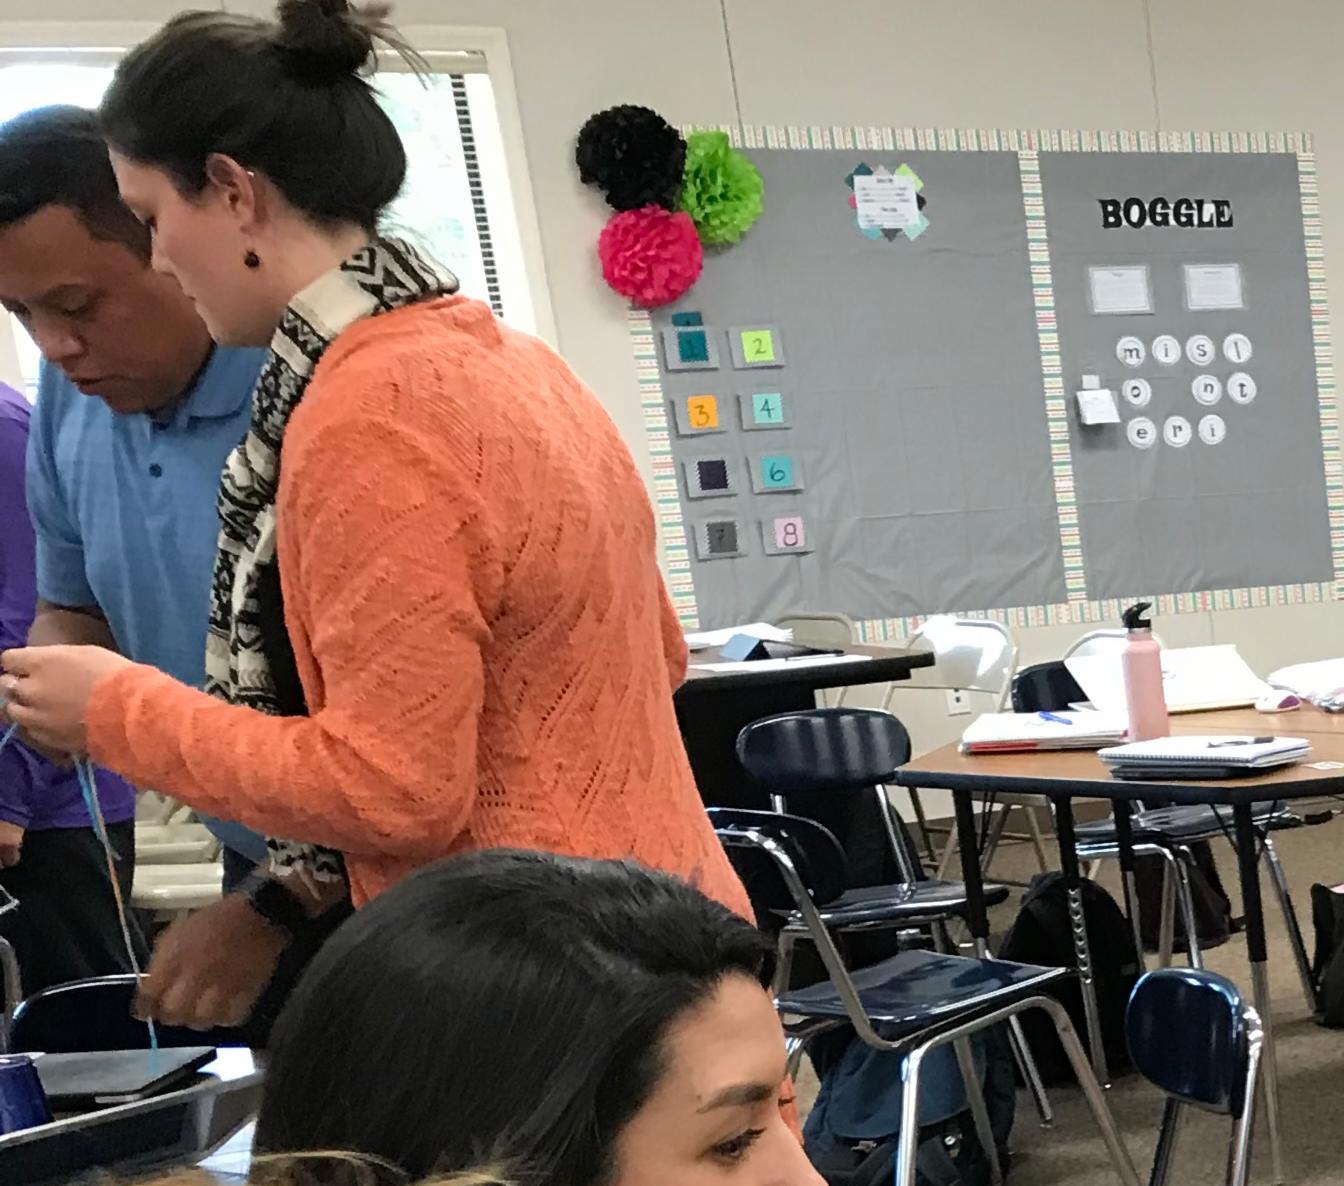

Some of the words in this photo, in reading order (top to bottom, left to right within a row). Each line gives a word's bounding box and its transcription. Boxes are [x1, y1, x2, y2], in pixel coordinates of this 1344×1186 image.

[1097, 196, 1234, 229] BOGGLE
[752, 337, 768, 355] 2
[1123, 346, 1141, 360] m
[1196, 343, 1208, 358] s
[1130, 385, 1142, 398] o
[692, 404, 710, 427] 3
[759, 398, 775, 419] 4
[1136, 427, 1148, 439] e
[1172, 424, 1183, 438] r
[769, 461, 786, 482] 6
[783, 522, 798, 547] 8
